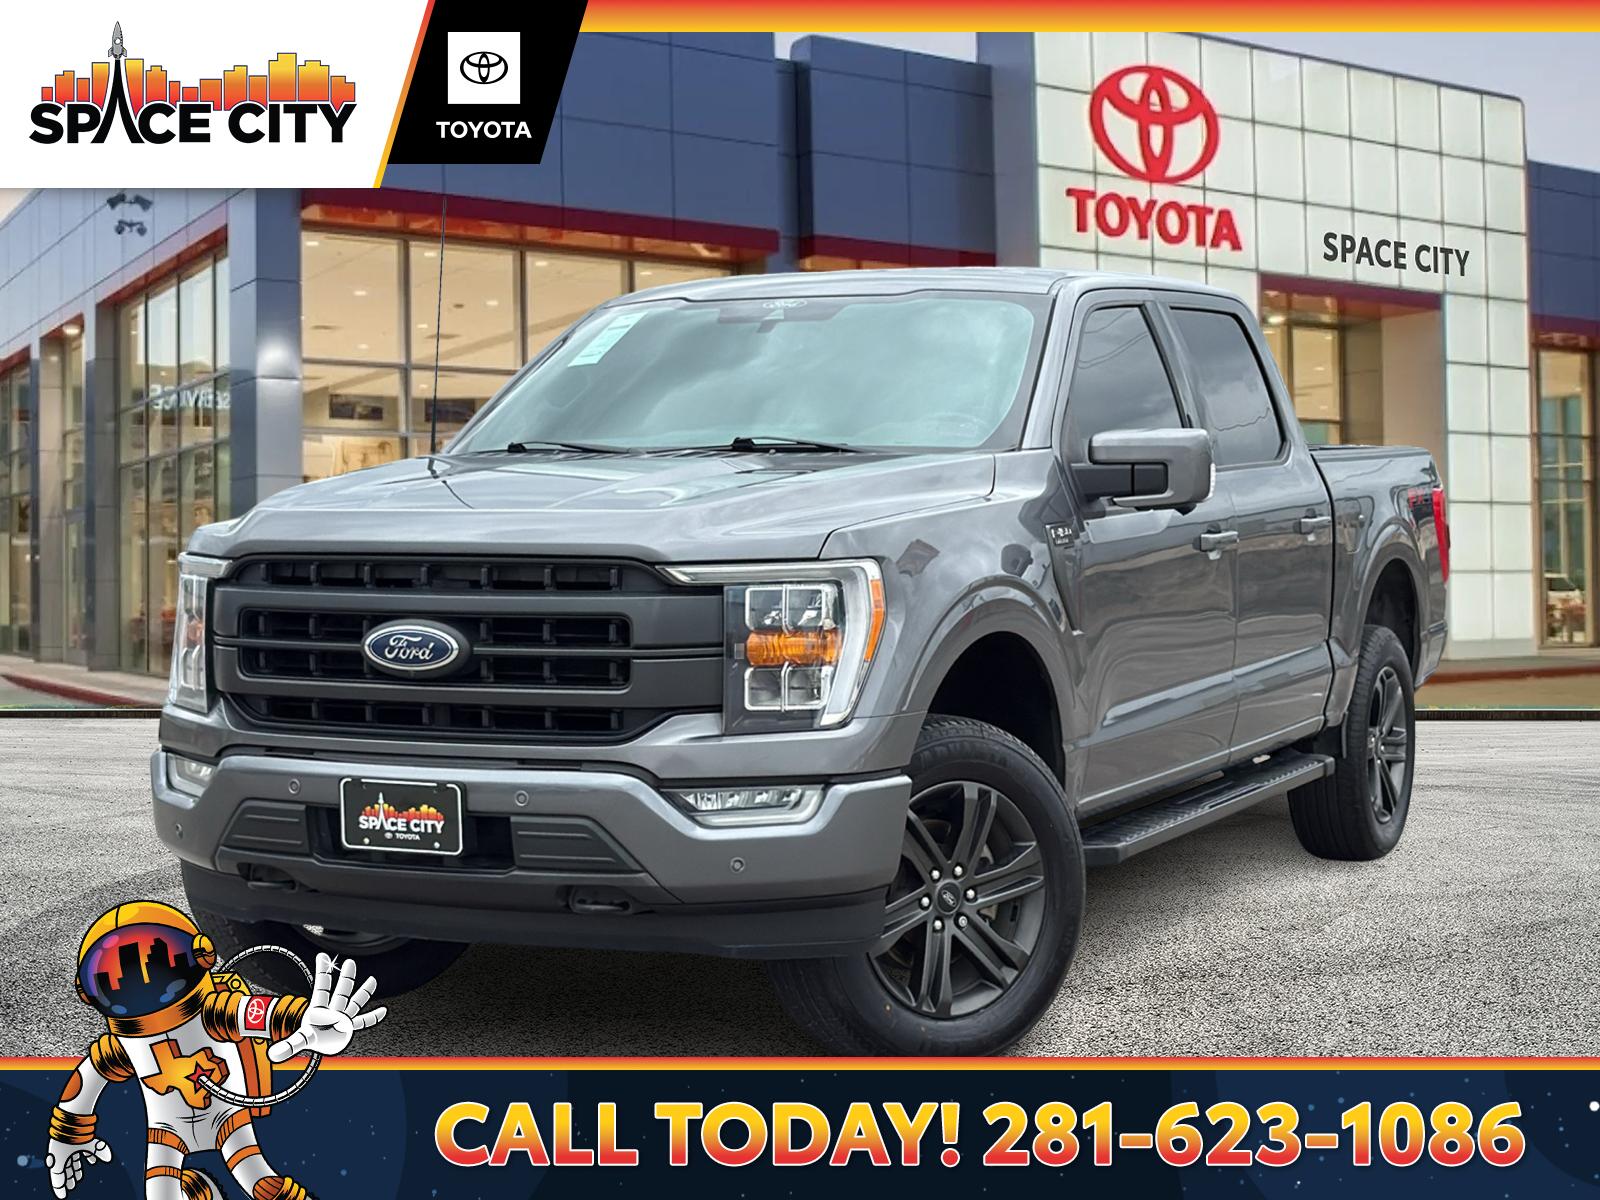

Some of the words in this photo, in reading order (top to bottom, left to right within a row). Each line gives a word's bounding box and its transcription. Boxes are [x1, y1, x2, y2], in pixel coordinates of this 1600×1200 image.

[1065, 188, 1243, 251] TOYOTA
[1323, 232, 1407, 269] SPACE
[1414, 243, 1470, 277] CITY
[384, 634, 435, 660] Ford
[359, 813, 407, 832] SPACE
[410, 819, 445, 834] CITY
[395, 832, 421, 841] TOYOTA
